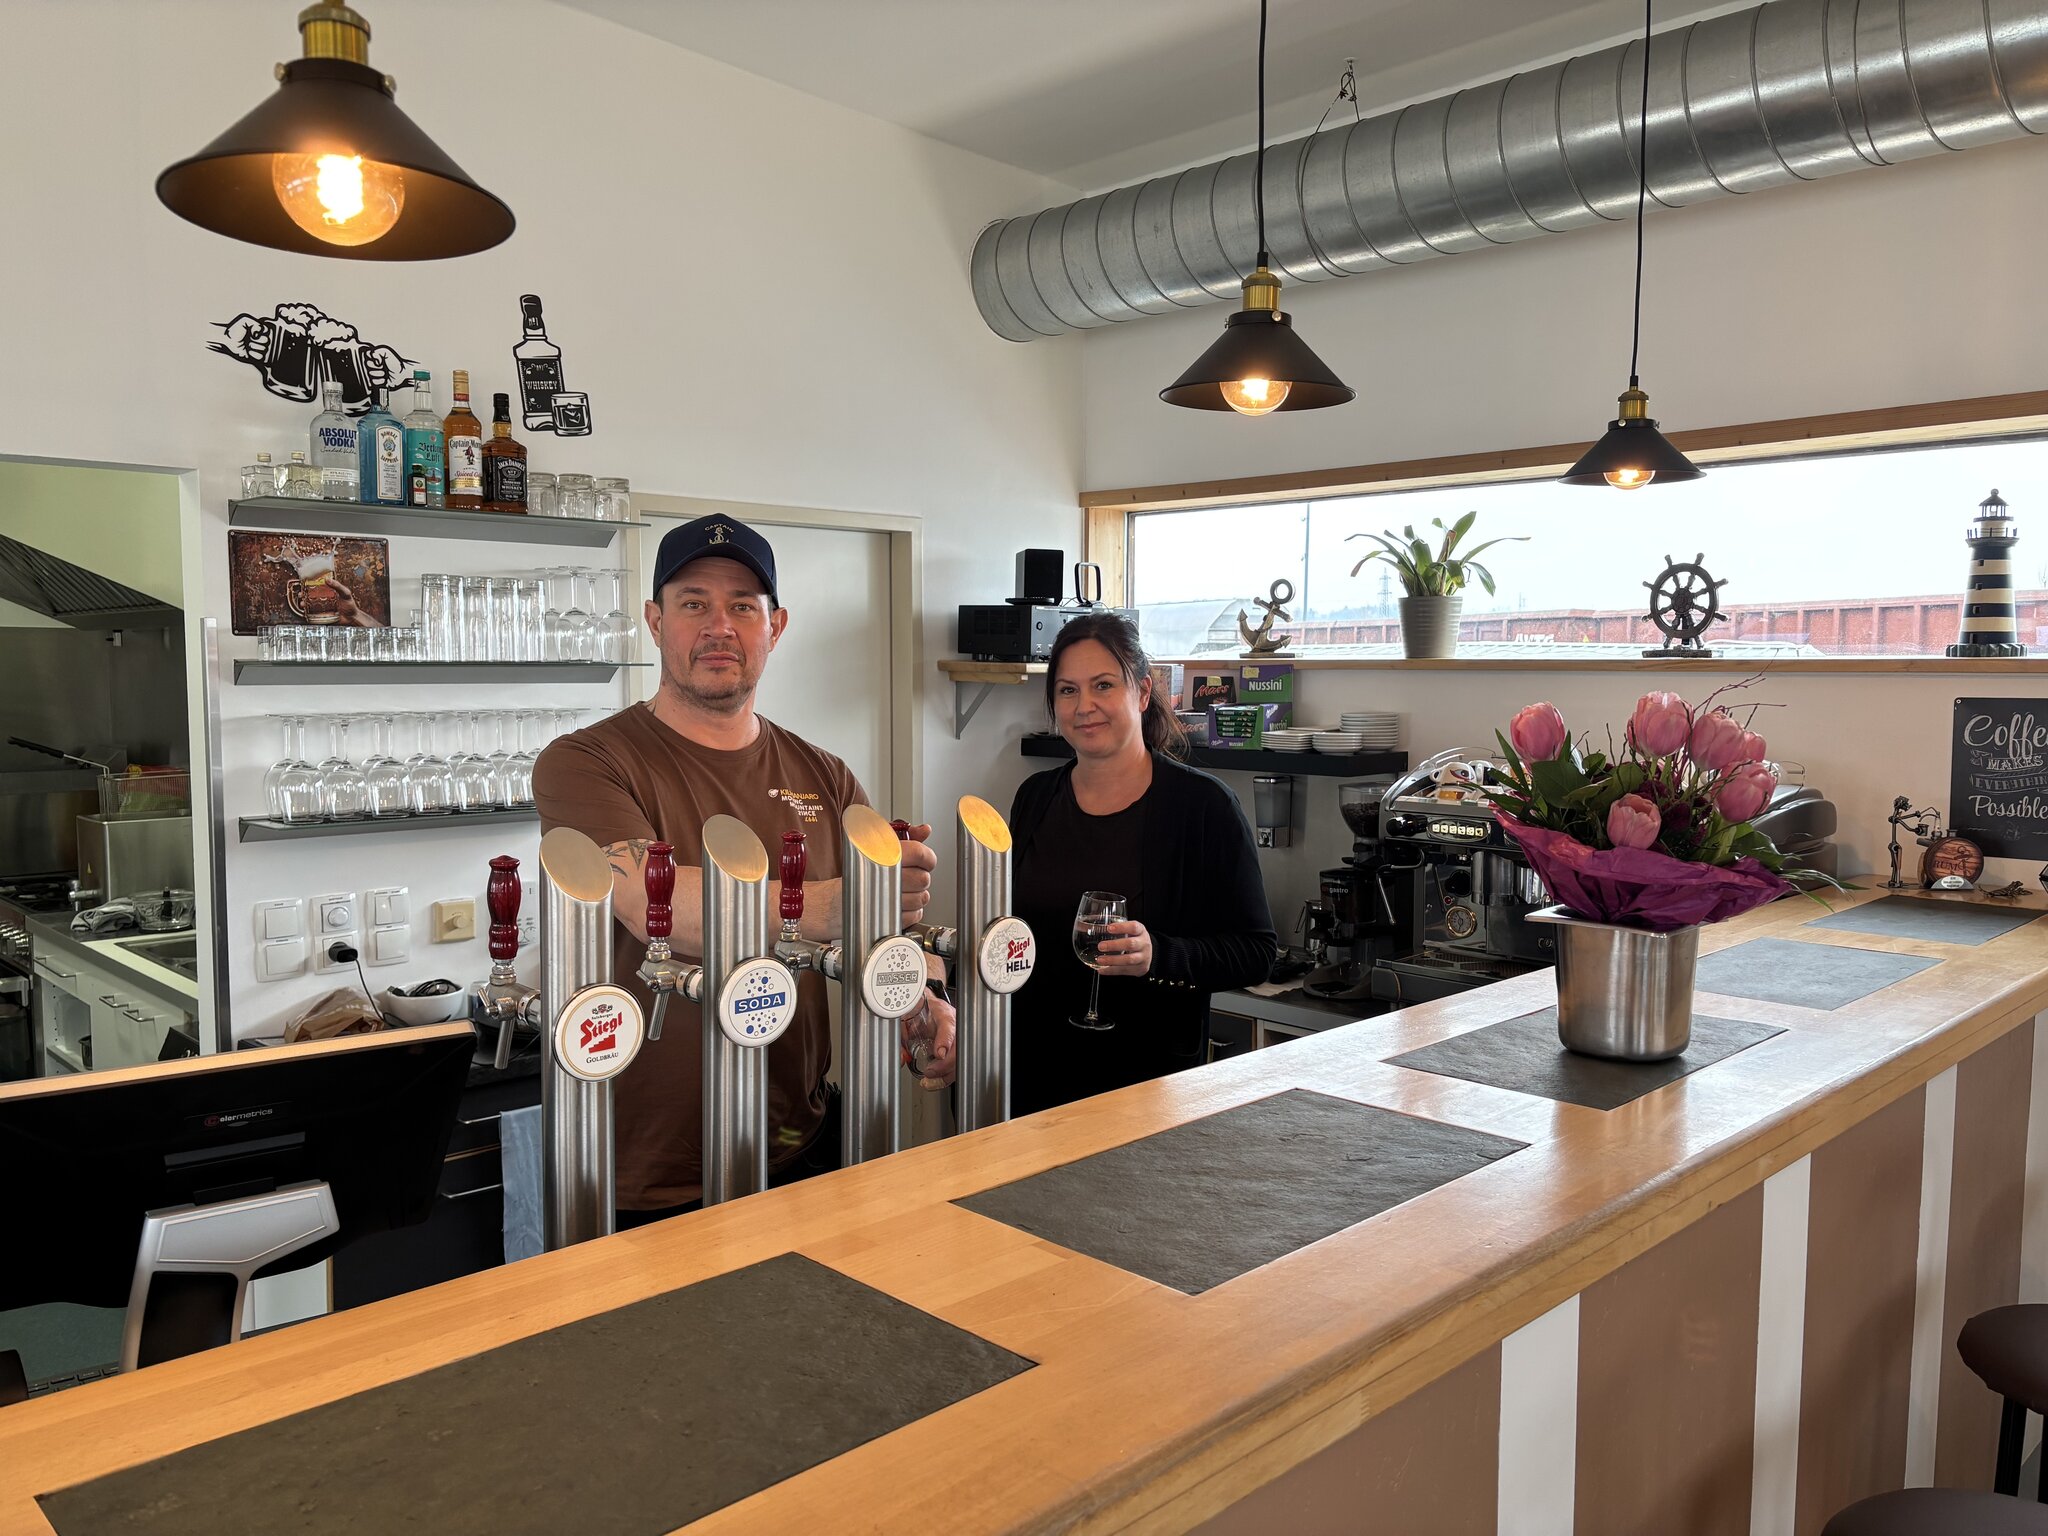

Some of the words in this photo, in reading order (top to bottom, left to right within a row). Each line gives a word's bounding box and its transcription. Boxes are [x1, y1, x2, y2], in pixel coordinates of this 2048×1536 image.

[525, 380, 558, 390] WHISKEY
[319, 427, 358, 440] ABSOLUT
[323, 437, 355, 448] VODKA
[449, 439, 469, 449] Captain
[497, 461, 508, 470] JACK
[1194, 684, 1230, 698] Mars
[1248, 679, 1283, 691] Nussini
[1964, 713, 2048, 760] Coffe
[1985, 755, 2044, 770] MAKES
[1975, 776, 2048, 790] EVERYTHIN
[1008, 937, 1030, 960] Stiegl
[1006, 959, 1031, 973] HELL
[878, 972, 918, 984] WASSER
[738, 994, 783, 1012] SODA
[580, 1012, 622, 1048] Stiegl
